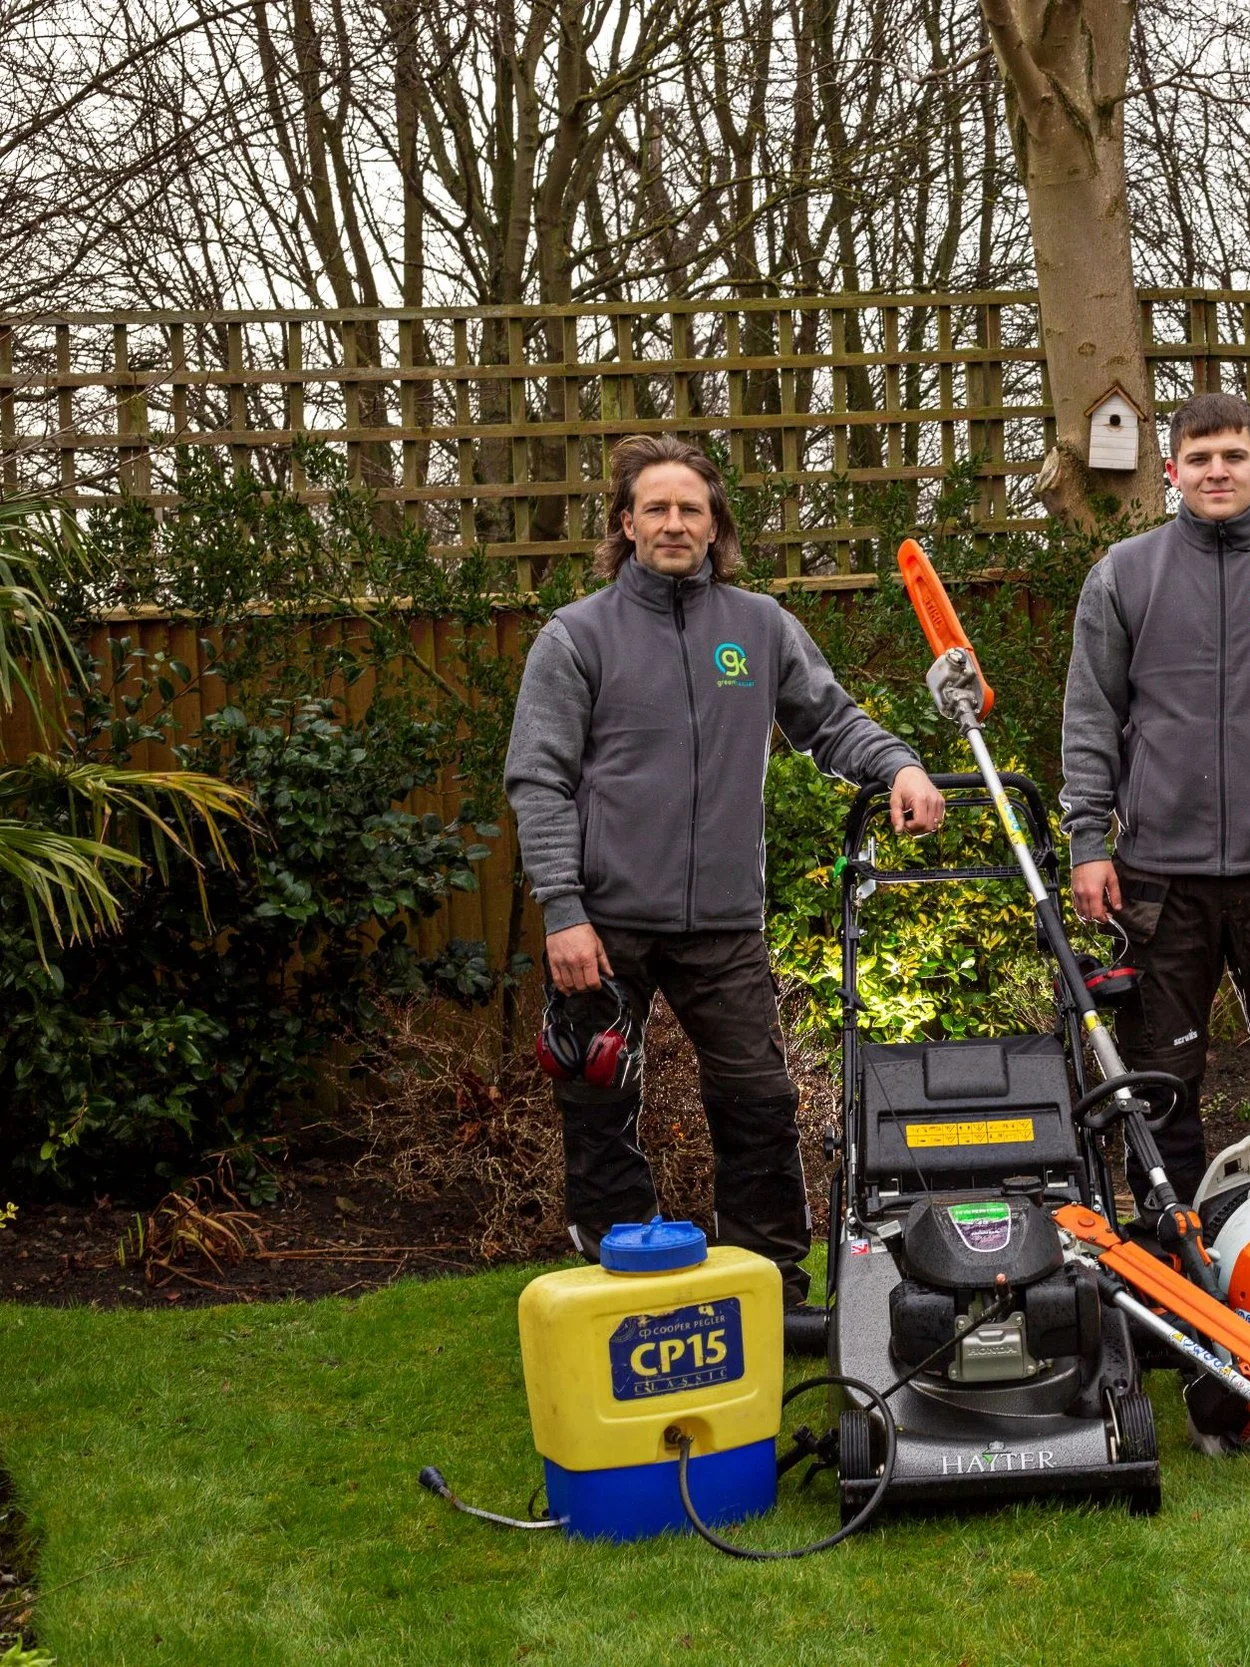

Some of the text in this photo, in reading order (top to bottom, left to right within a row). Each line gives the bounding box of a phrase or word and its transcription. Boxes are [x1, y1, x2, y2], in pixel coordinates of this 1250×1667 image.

[653, 1322, 691, 1335] COOPER
[694, 1315, 726, 1329] PEGLER
[630, 1329, 727, 1376] CP15
[634, 1369, 727, 1393] CLASSIC
[942, 1450, 1055, 1475] HAYTER
